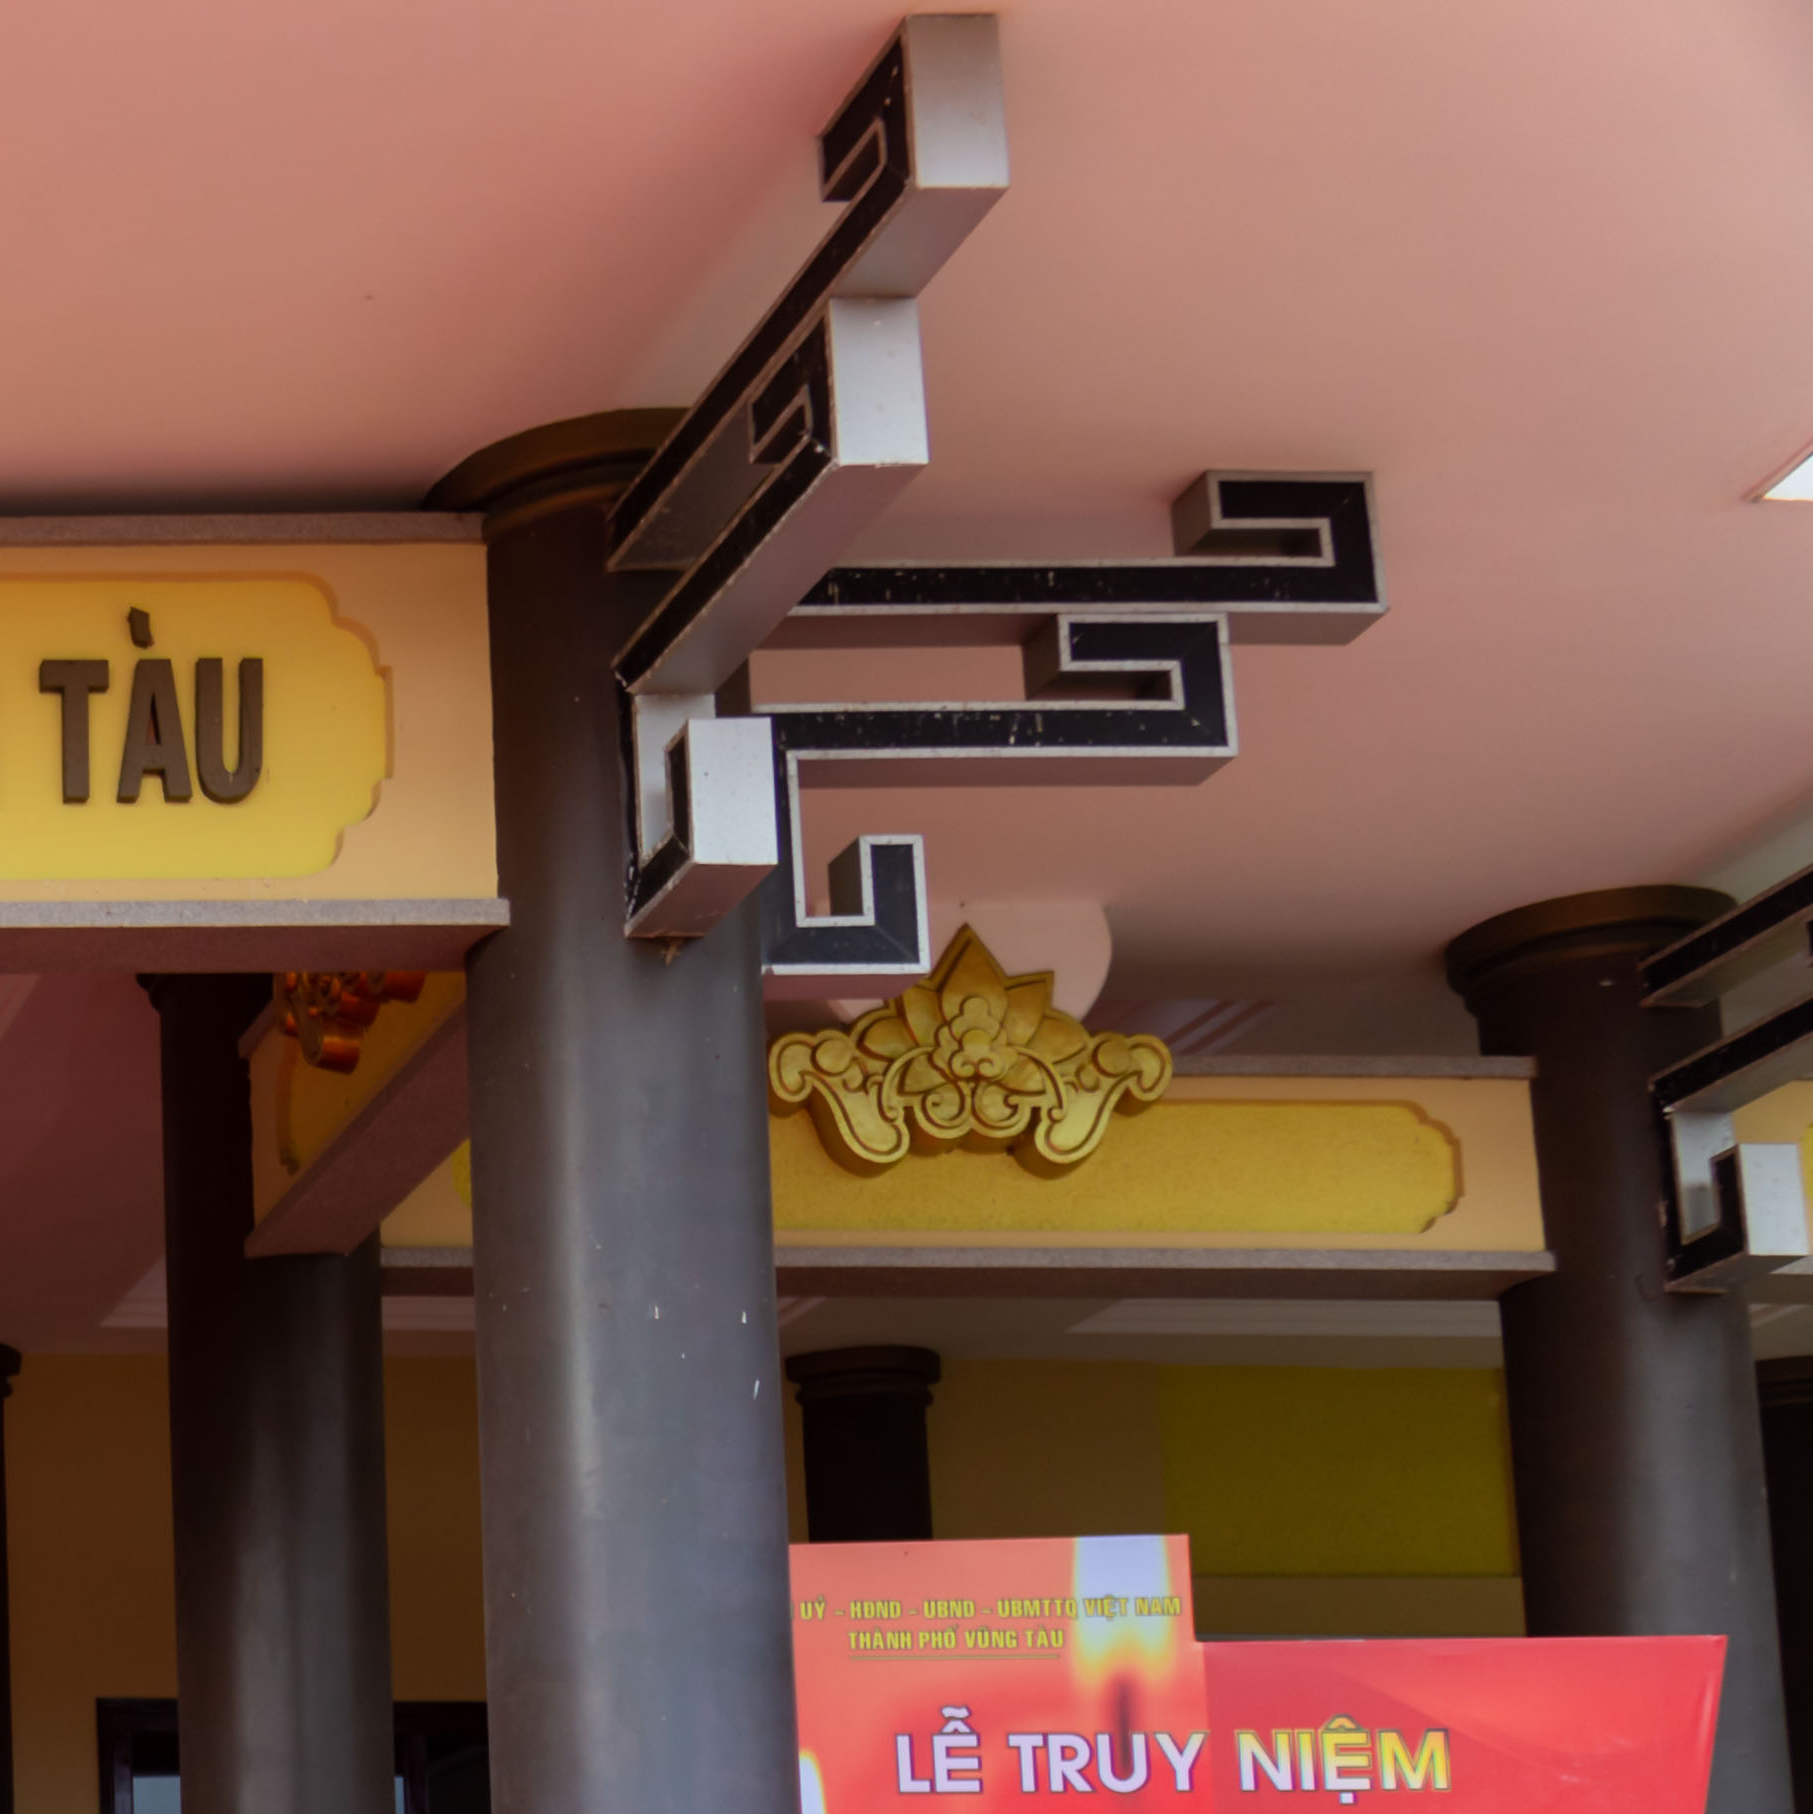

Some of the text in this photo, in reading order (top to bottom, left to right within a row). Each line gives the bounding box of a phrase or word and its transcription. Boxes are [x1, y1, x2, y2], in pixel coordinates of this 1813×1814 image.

[38, 606, 265, 806] TÀU
[848, 1624, 1065, 1650] THÀNH PHỐ VŨNG TÀU
[849, 1600, 902, 1620] HĐND
[923, 1599, 976, 1619] UBND
[1084, 1594, 1129, 1622] VIỆT
[1136, 1596, 1183, 1617] NAM
[895, 1705, 1452, 1806] LỄ TRUY NIỆM
